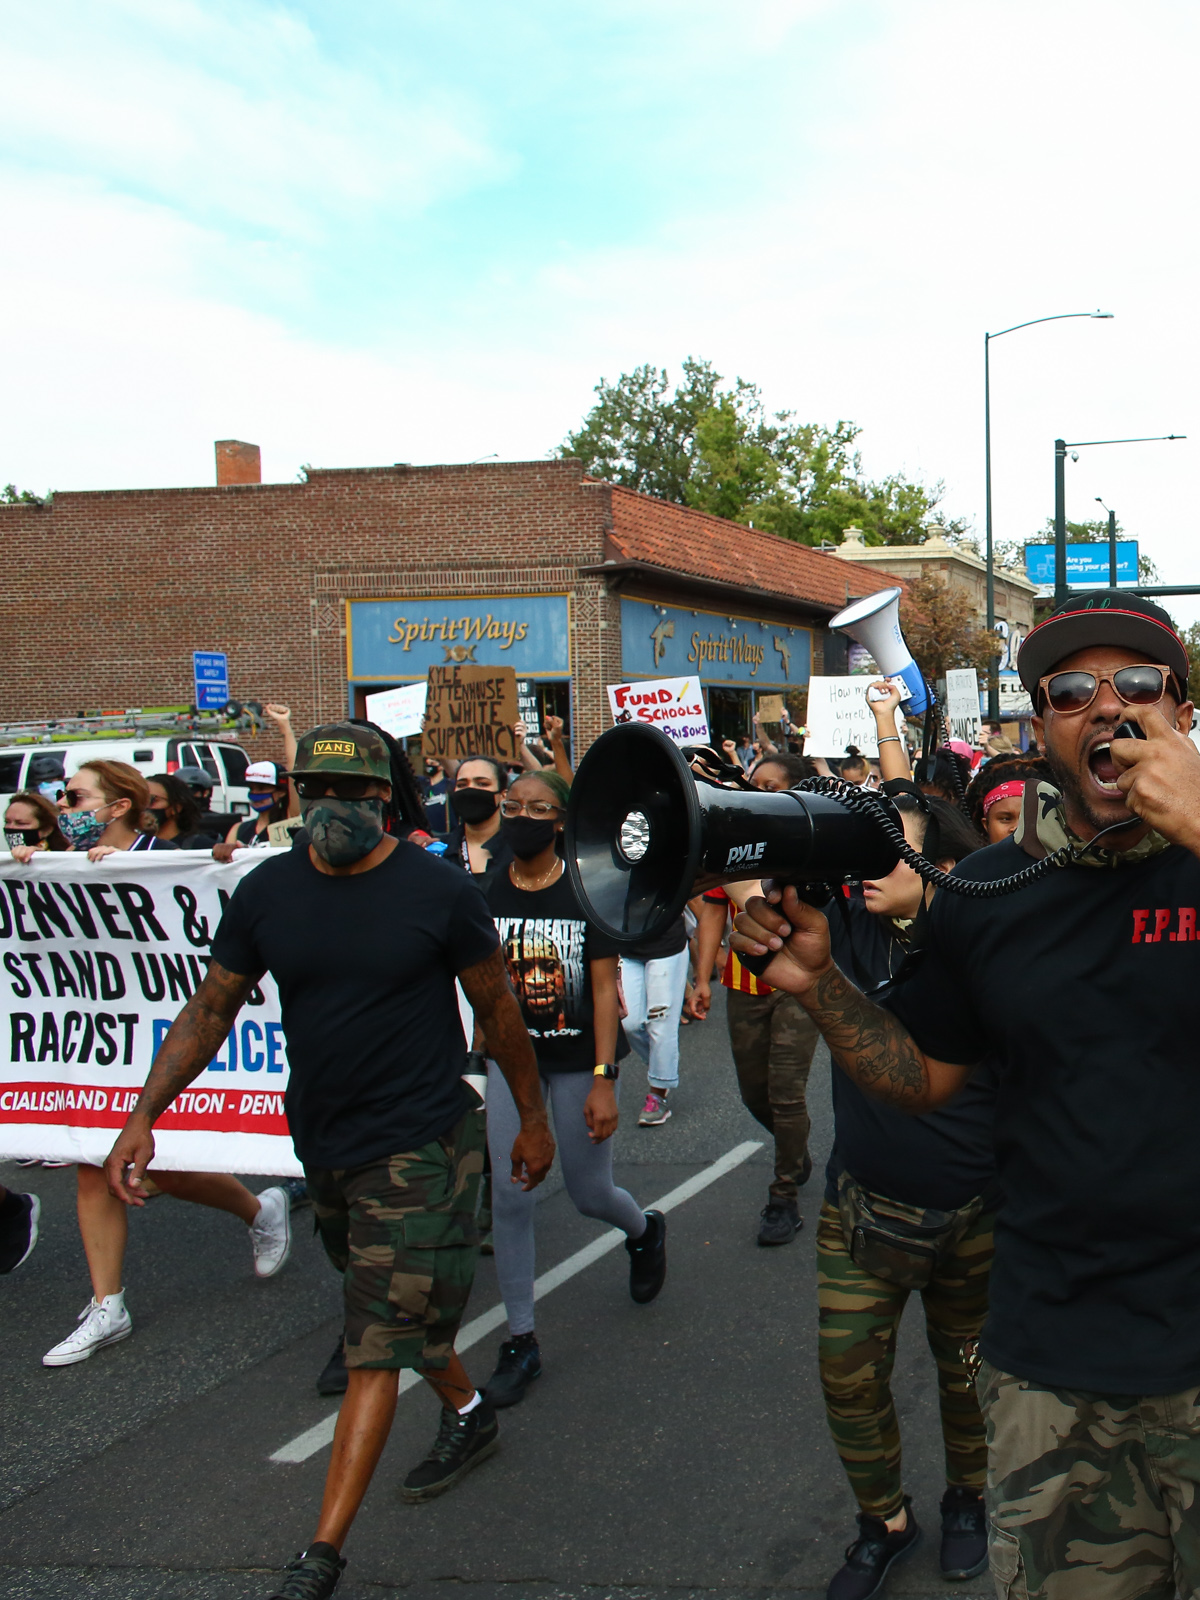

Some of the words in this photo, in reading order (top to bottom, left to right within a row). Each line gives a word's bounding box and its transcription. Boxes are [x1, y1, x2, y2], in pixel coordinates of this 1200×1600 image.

[1100, 561, 1128, 571] piter?
[428, 666, 461, 684] KYLE
[614, 686, 672, 708] FUND
[829, 685, 851, 702] How
[425, 702, 441, 722] IS
[449, 701, 503, 726] WHITE
[637, 704, 702, 723] SCHOOLS
[427, 725, 519, 758] SUPREMACY
[663, 725, 707, 739] PRISONS
[832, 727, 877, 747] filmed
[317, 743, 351, 753] VANS
[726, 843, 766, 865] PYLE
[173, 885, 213, 947] &
[3, 950, 126, 1001] STAND
[10, 1011, 139, 1065] RACIST
[64, 1090, 108, 1110] AND
